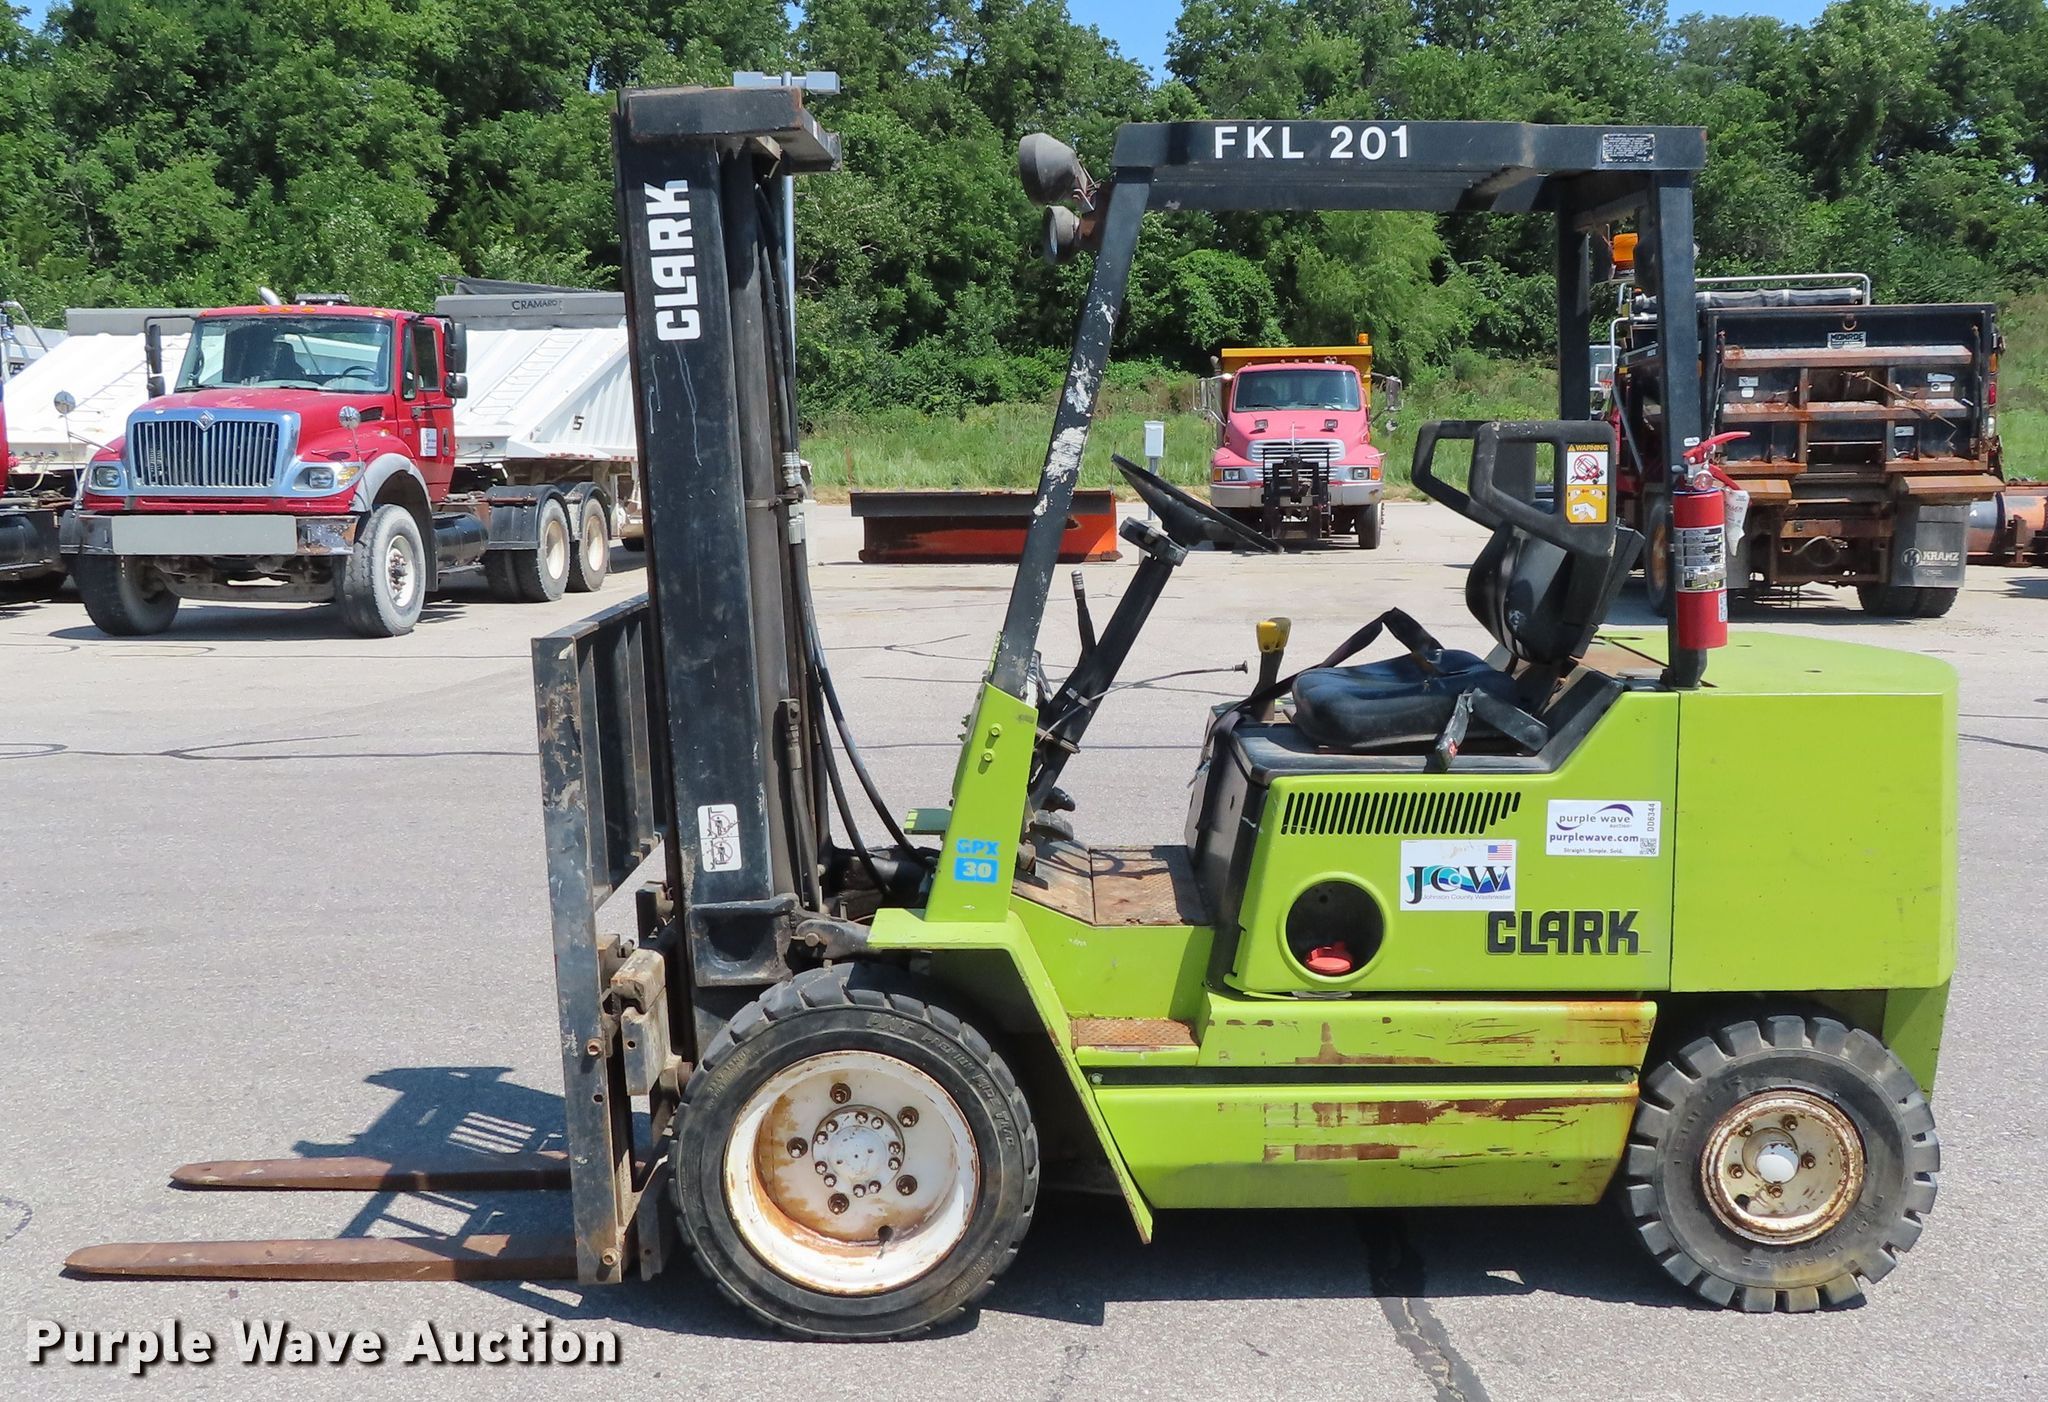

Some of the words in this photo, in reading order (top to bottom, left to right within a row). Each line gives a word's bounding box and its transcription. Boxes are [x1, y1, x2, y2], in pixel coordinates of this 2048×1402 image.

[1214, 125, 1305, 159] FKL
[1329, 124, 1408, 161] 201
[643, 179, 701, 341] CLARK
[511, 299, 558, 311] CRAMARO
[572, 415, 585, 431] 5
[1559, 814, 1597, 824] purple
[1600, 814, 1631, 823] wave
[1549, 833, 1639, 843] purplewave.com
[956, 838, 1000, 856] GPX
[962, 861, 992, 878] 30
[1404, 865, 1512, 905] JCW
[1423, 893, 1450, 901] Johnson
[1450, 893, 1473, 902] County
[1486, 910, 1640, 954] CLARK
